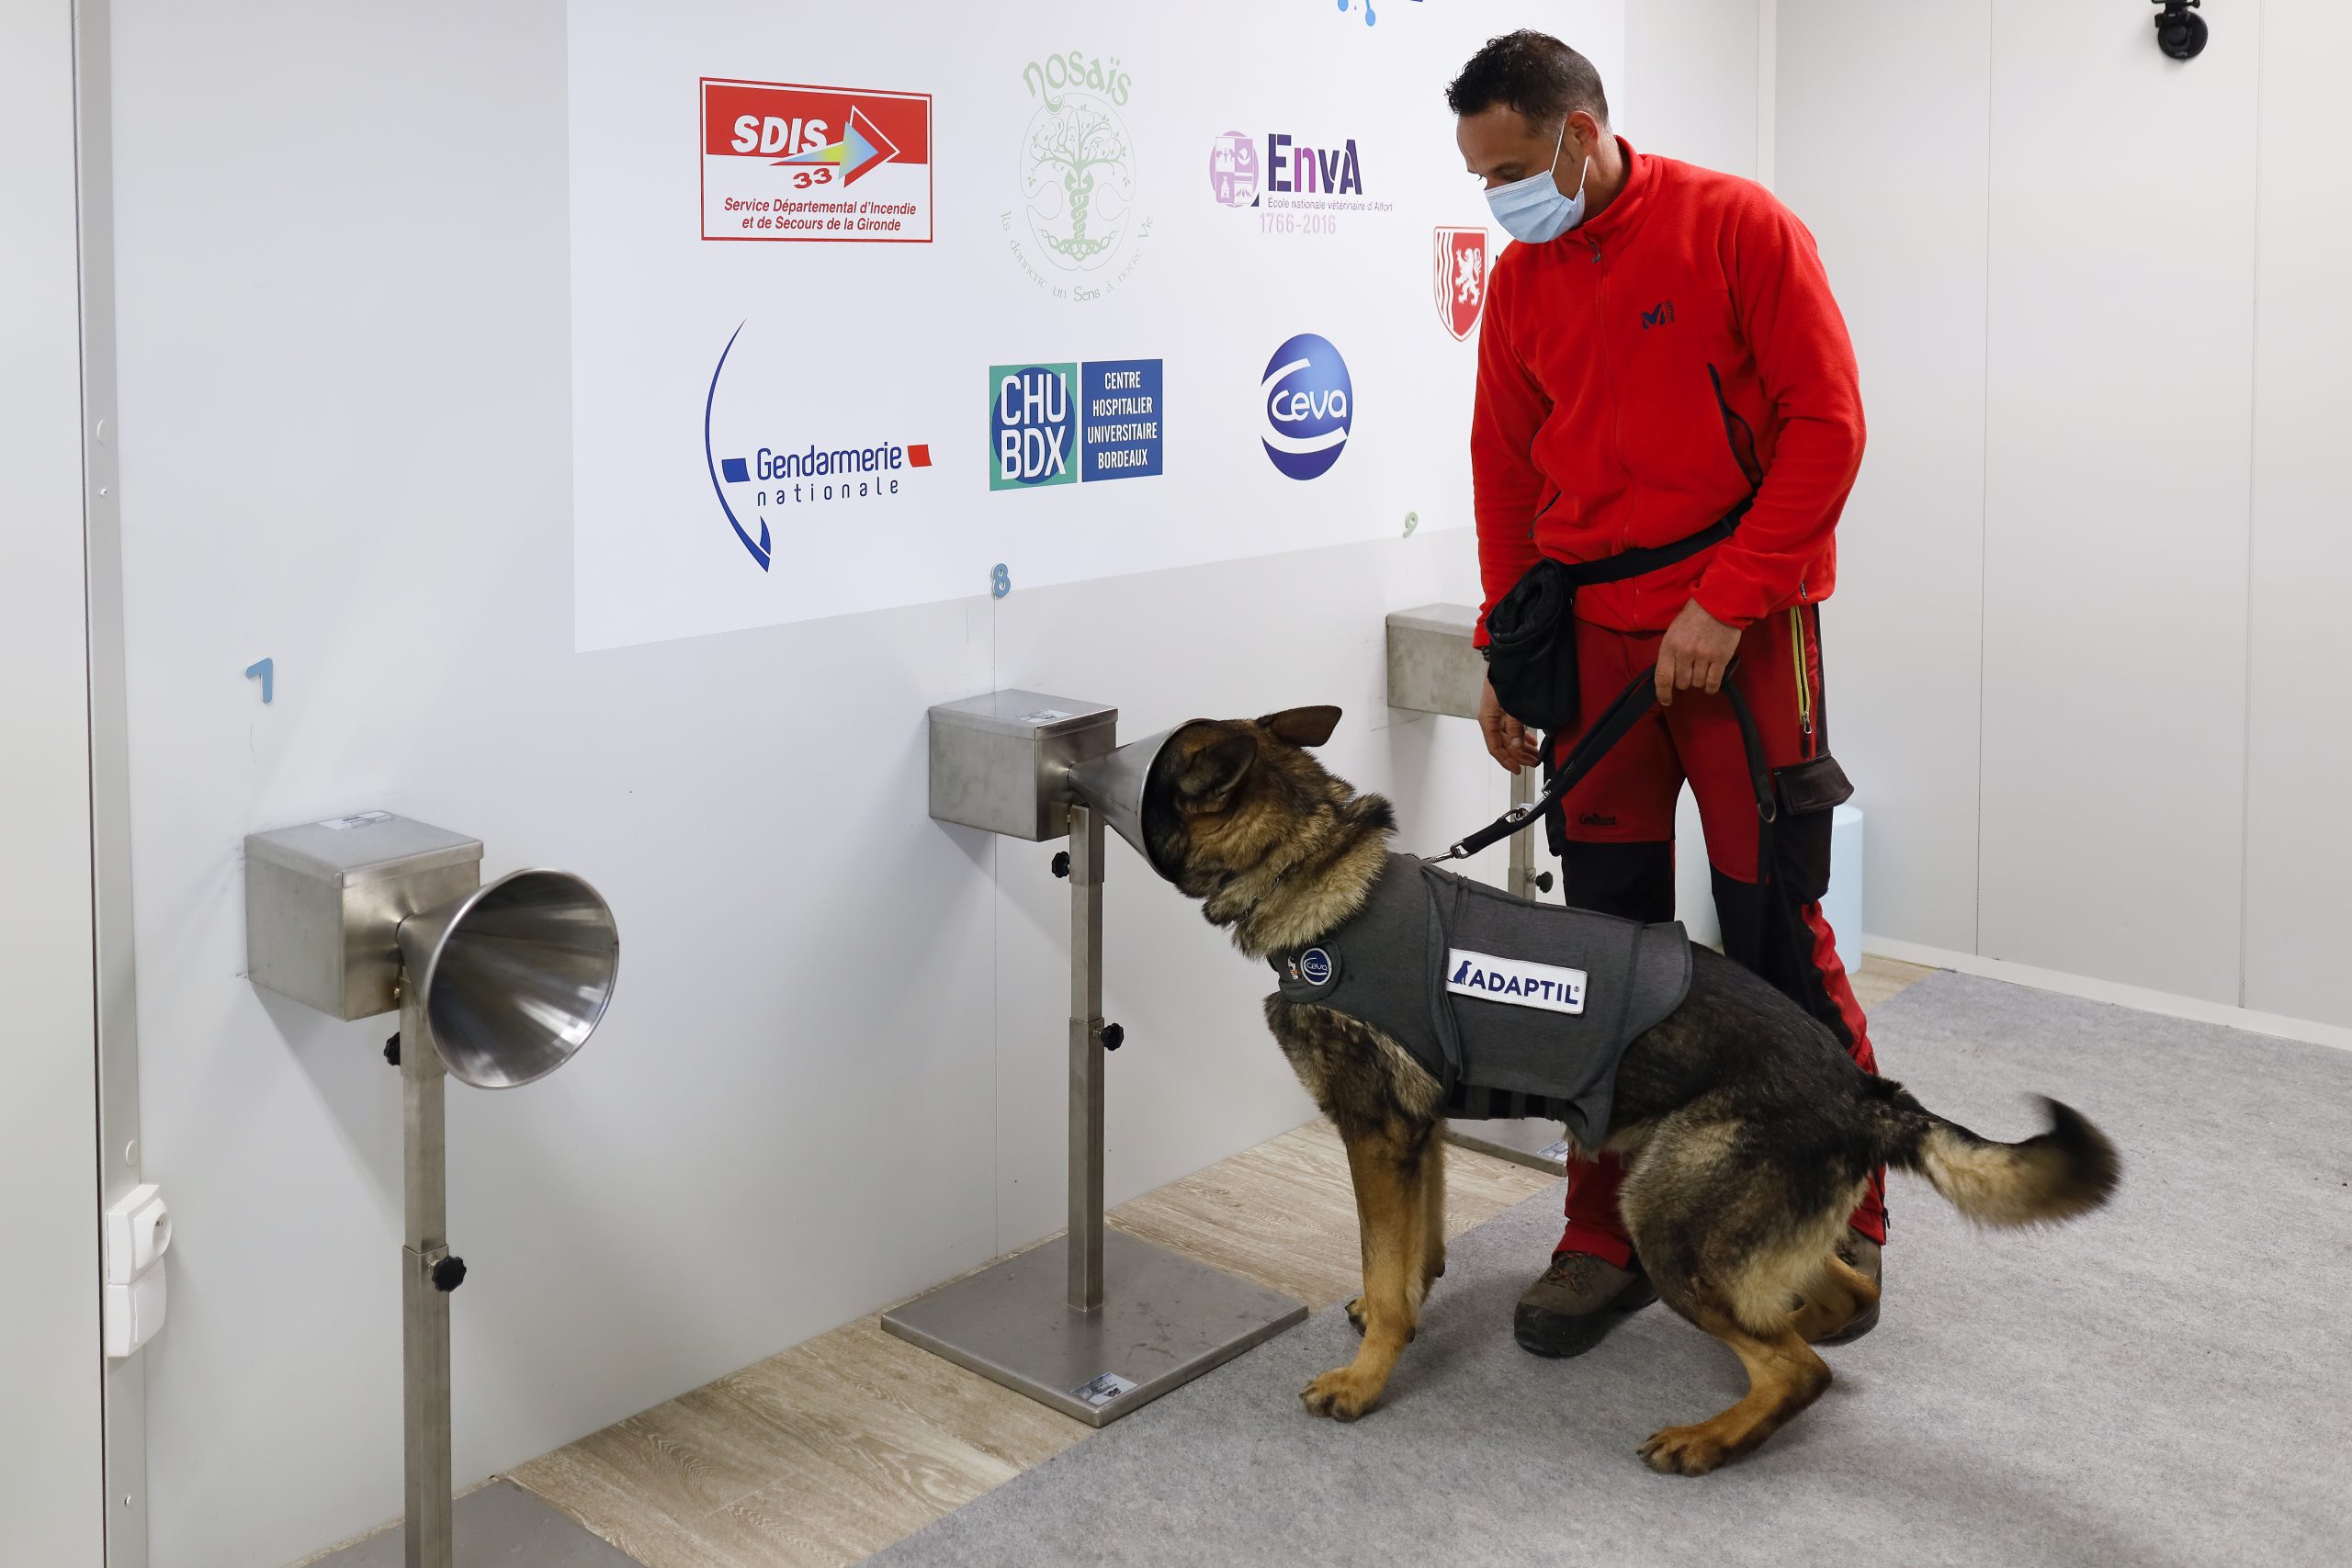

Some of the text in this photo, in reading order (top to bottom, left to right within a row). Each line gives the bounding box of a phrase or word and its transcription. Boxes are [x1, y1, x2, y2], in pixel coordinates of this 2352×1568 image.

[730, 115, 829, 154] SDIS
[1268, 133, 1363, 195] EnvA
[793, 168, 832, 189] 33
[724, 197, 916, 216] Service Départemental d'Incendie
[1291, 199, 1326, 209] nationale
[1328, 199, 1365, 210] vétérinaire
[742, 216, 901, 231] et de Secours de la Gironde
[1260, 212, 1337, 234] 1766-2016
[1073, 286, 1101, 302] Sens
[1104, 371, 1141, 390] CENTRE
[1001, 372, 1067, 426] CHU
[1092, 396, 1153, 417] HOSPITALIER
[1087, 422, 1158, 444] UNIVERSITAIRE
[757, 441, 902, 481] Gendarmerie
[1001, 425, 1067, 480] BDX
[1098, 448, 1148, 469] BORDEAUX
[757, 476, 899, 506] nationale
[1402, 511, 1419, 539] 9
[990, 562, 1012, 600] 8
